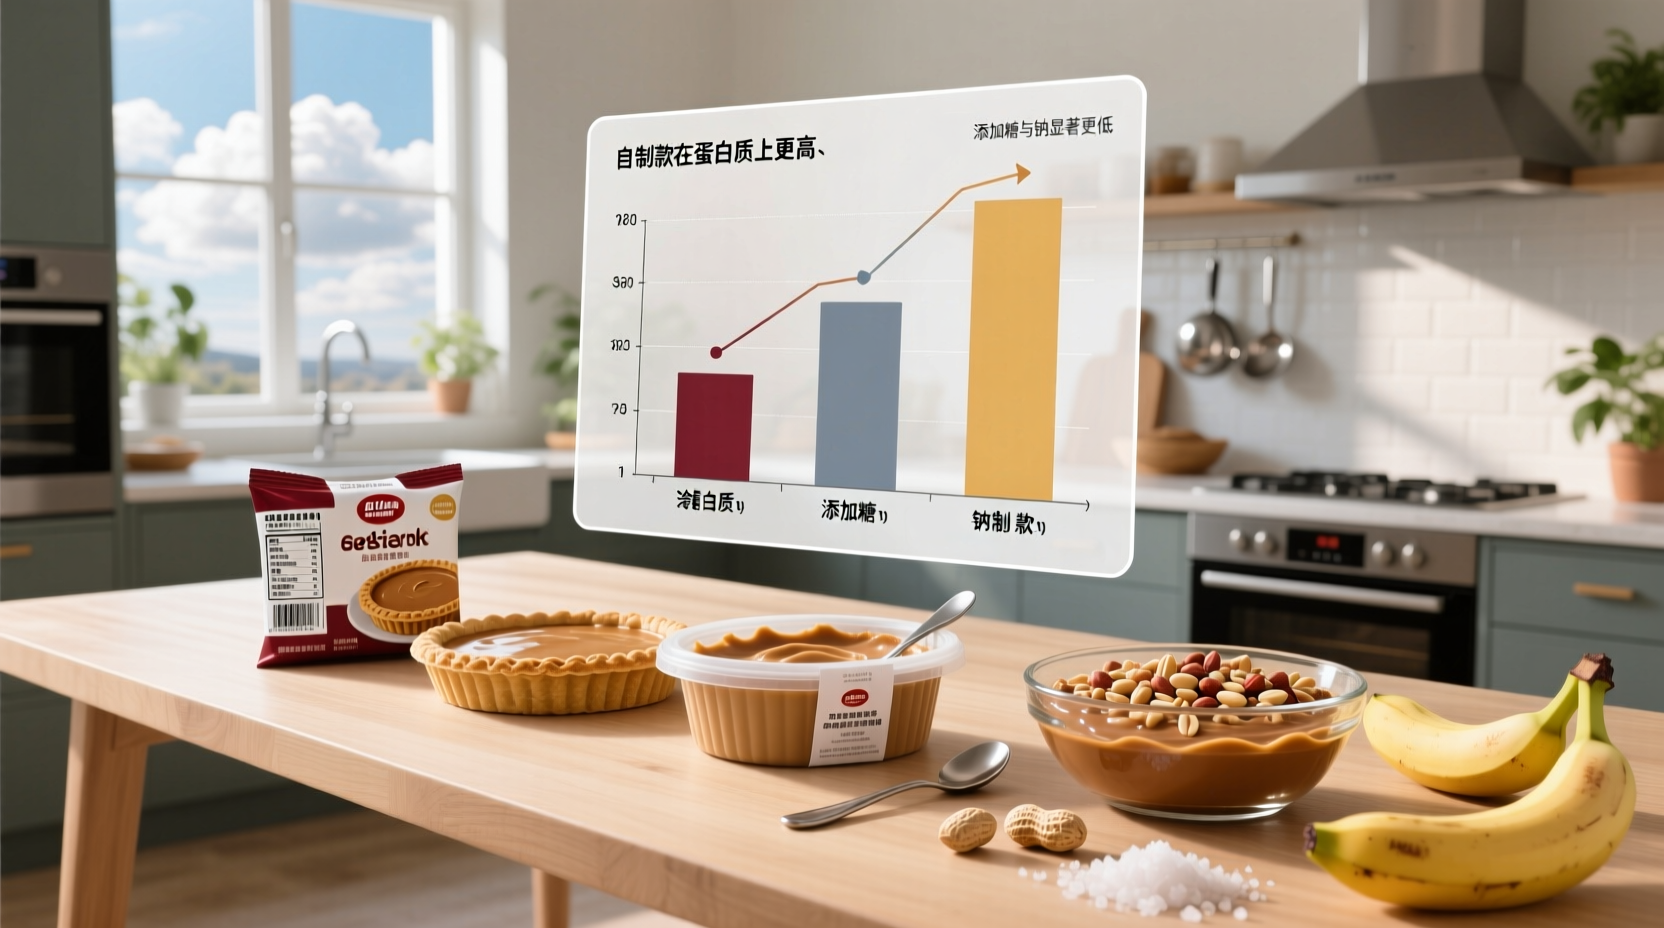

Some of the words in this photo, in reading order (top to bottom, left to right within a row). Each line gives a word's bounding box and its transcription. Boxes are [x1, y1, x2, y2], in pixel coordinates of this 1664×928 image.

[973, 116, 1114, 140] 添加糖与钠显著更低
